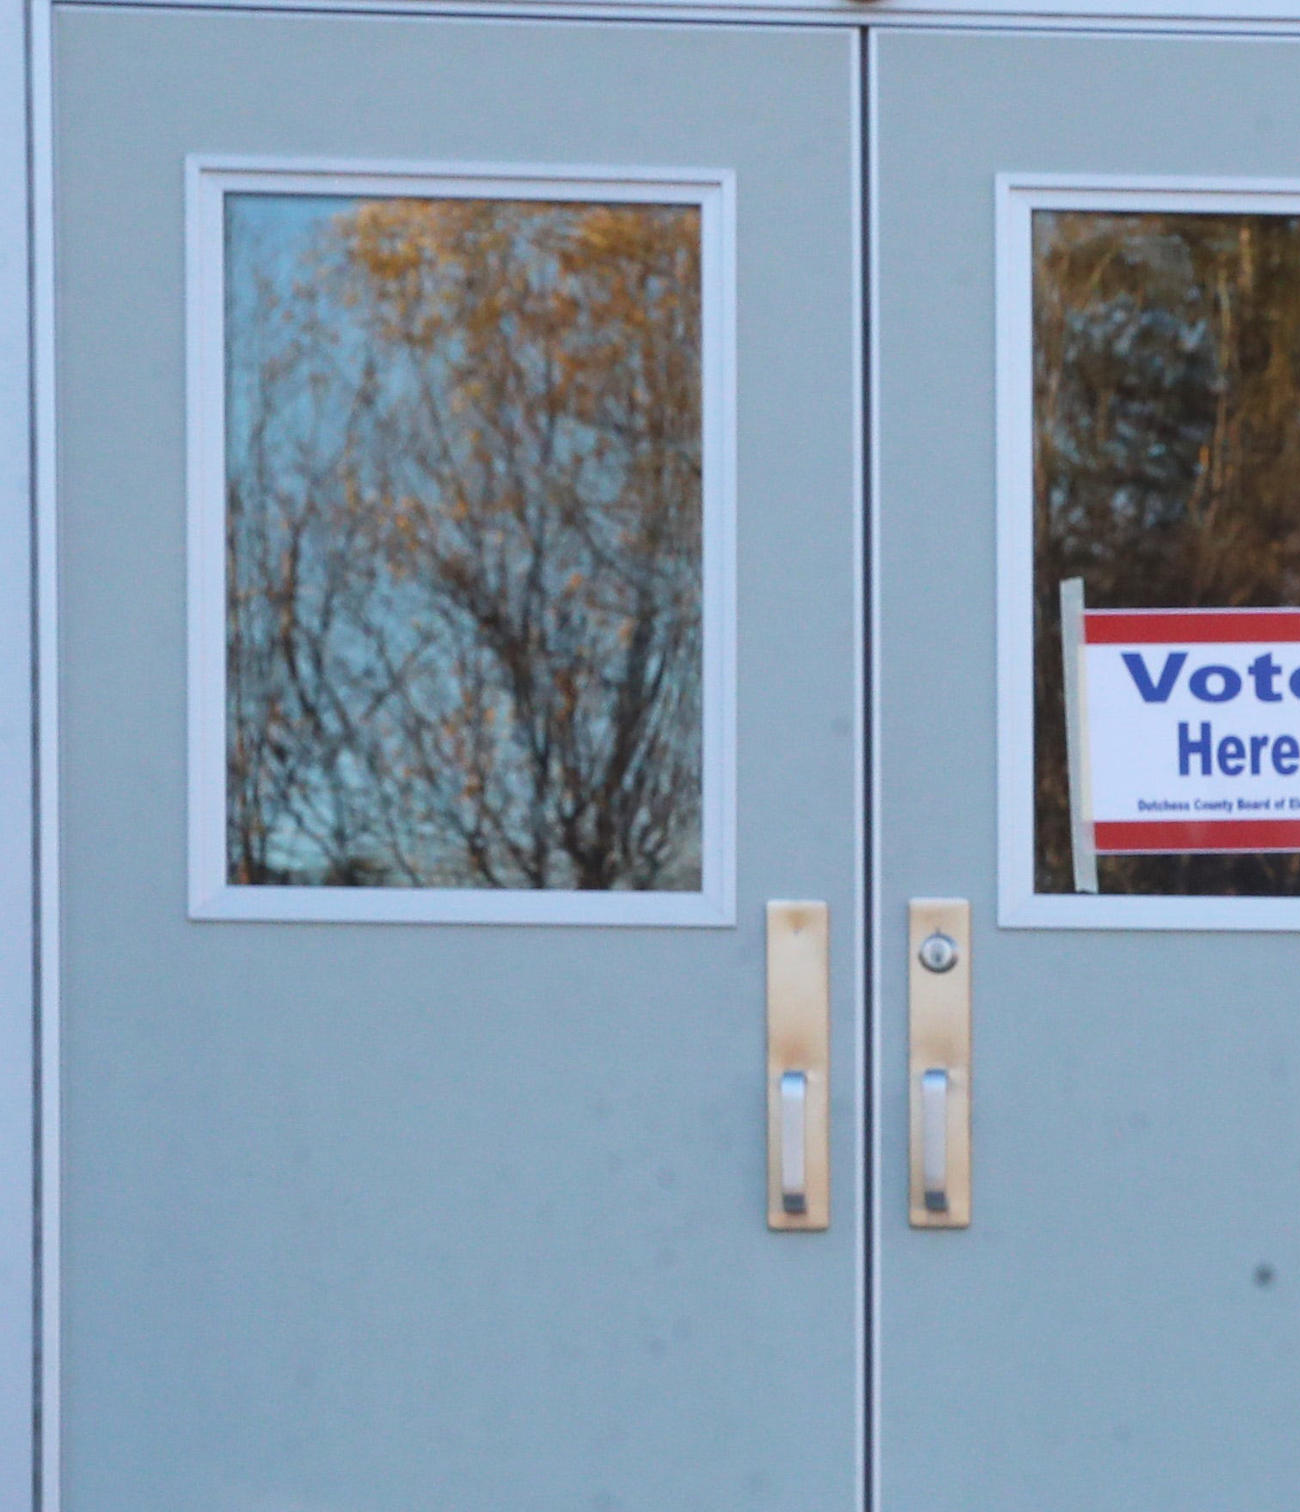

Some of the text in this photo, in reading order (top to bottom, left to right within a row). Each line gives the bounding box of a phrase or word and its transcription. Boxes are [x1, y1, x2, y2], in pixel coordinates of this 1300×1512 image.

[1178, 720, 1300, 777] Here
[1137, 799, 1190, 812] Dutchess
[1194, 798, 1233, 813] County
[1237, 798, 1270, 811] Board
[1274, 798, 1285, 810] of
